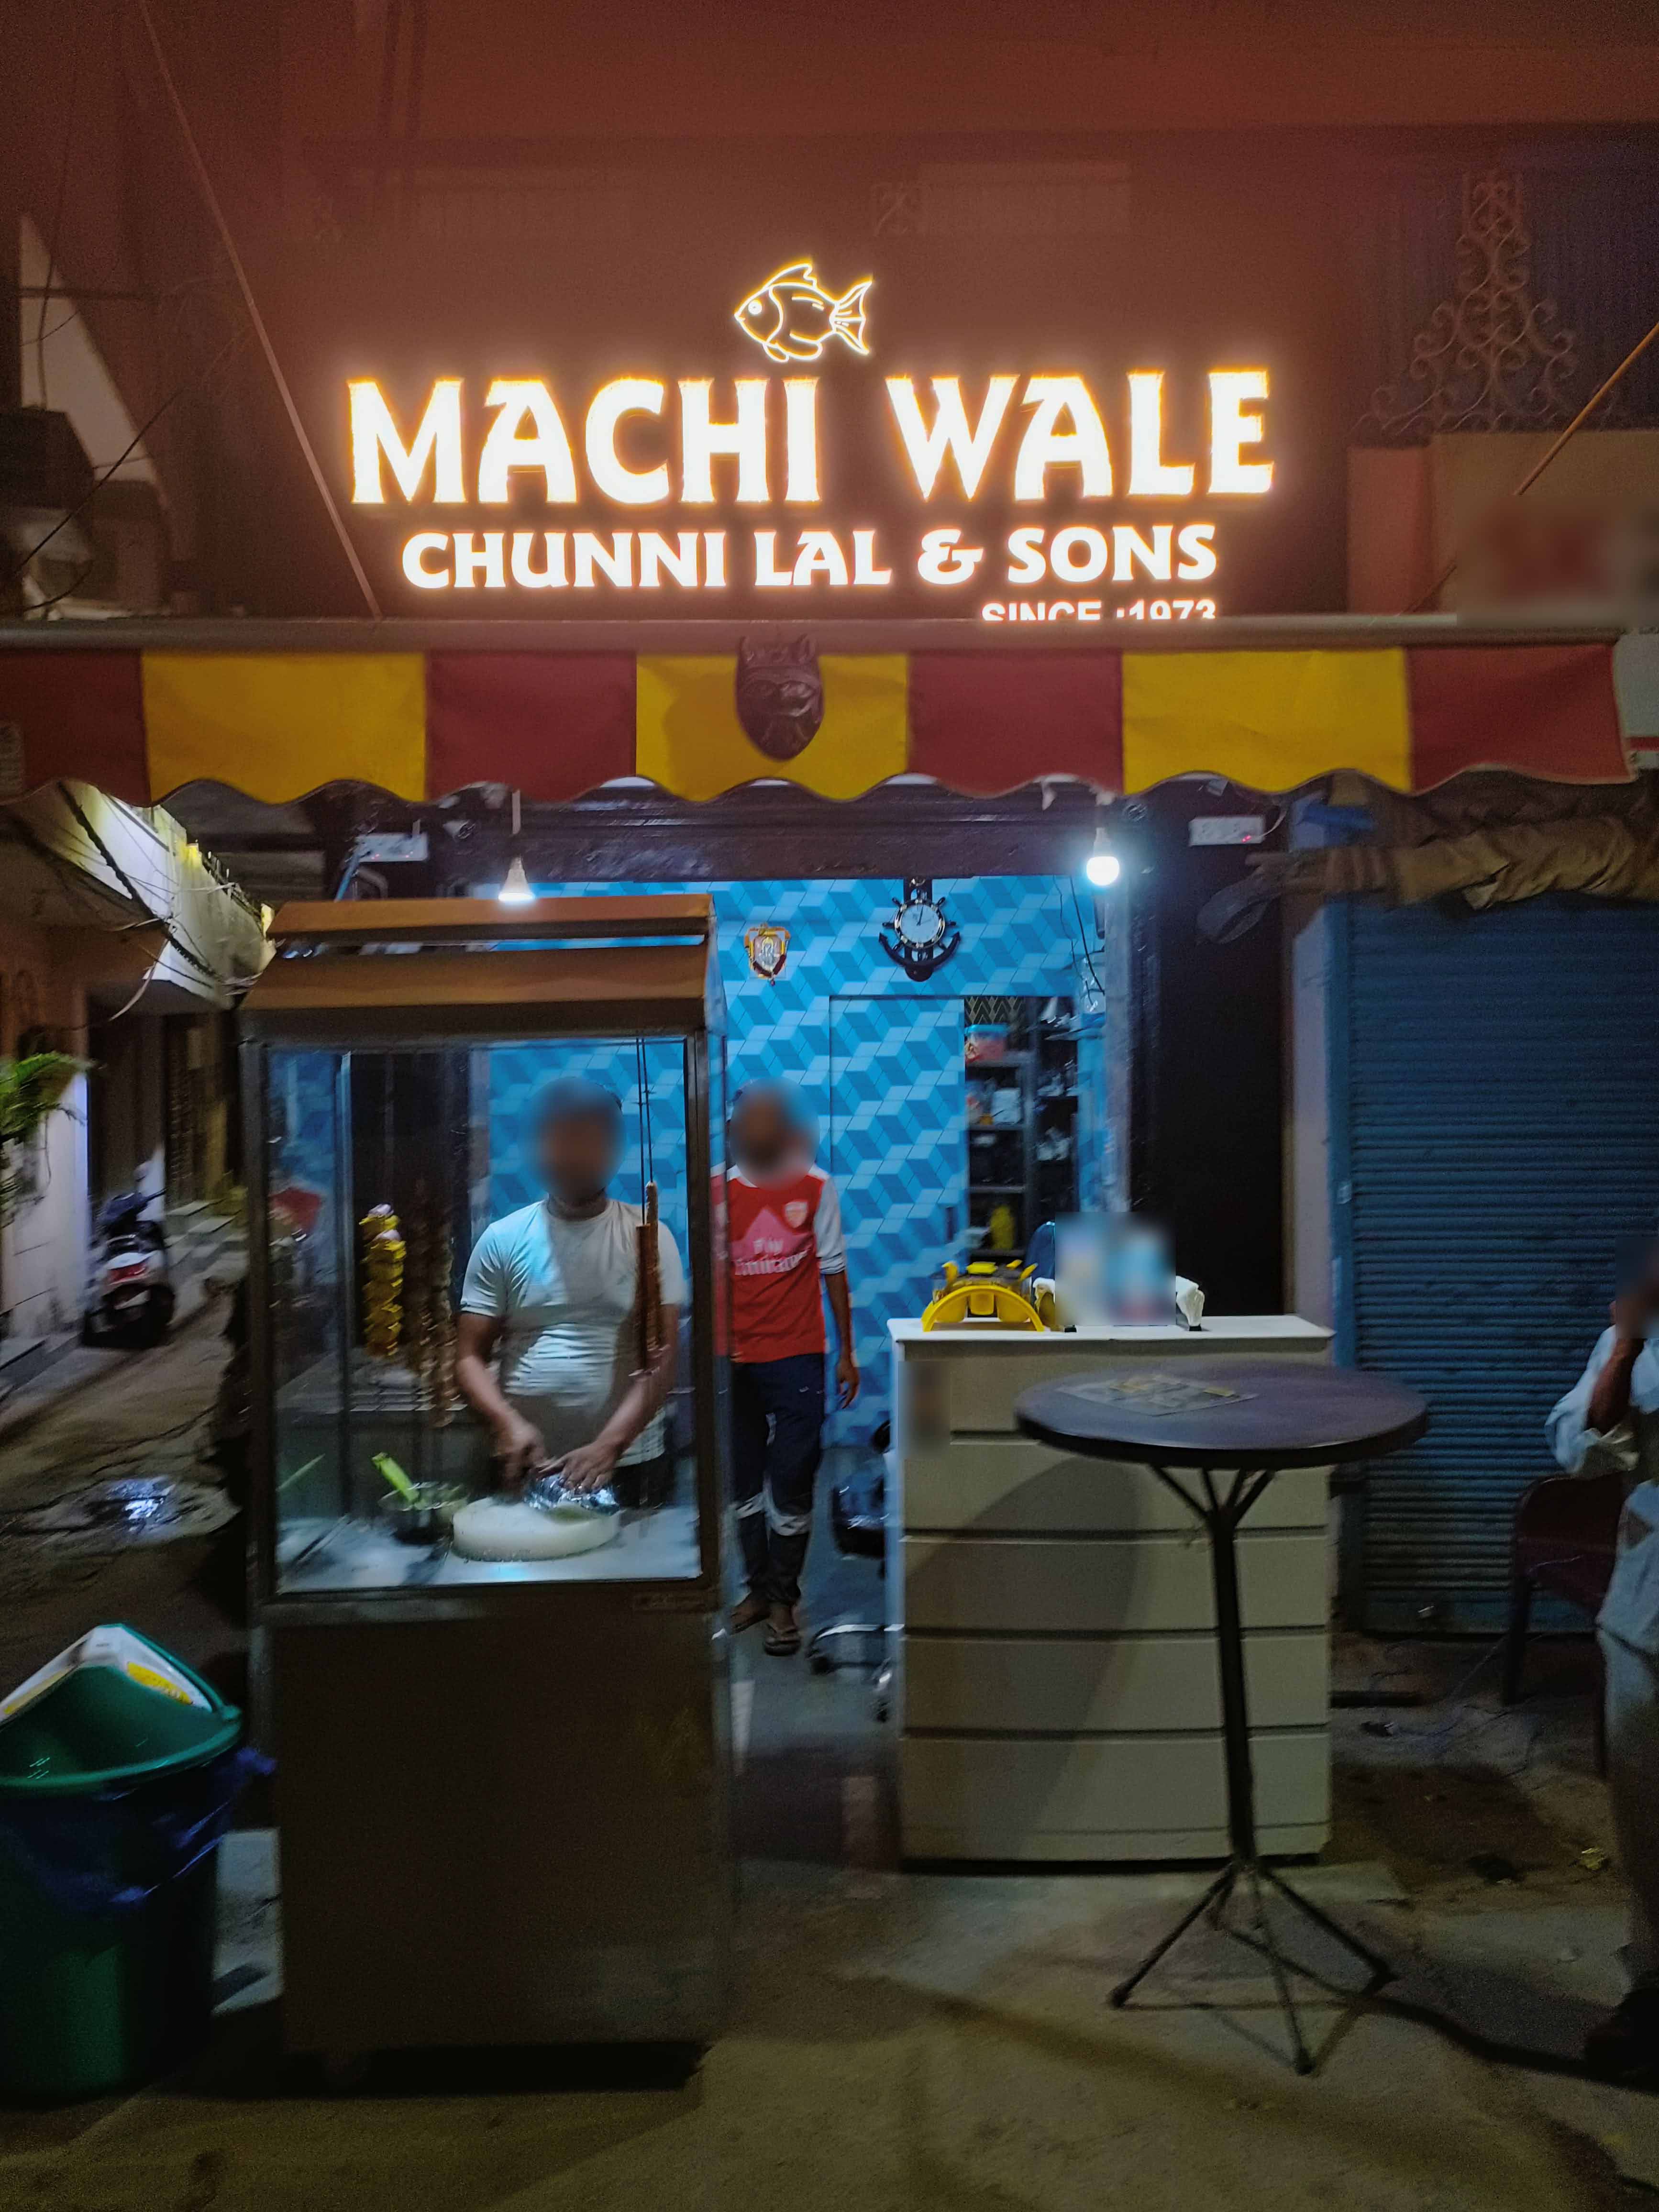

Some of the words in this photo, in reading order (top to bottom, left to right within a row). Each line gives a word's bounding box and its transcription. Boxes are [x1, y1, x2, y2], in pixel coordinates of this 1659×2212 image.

[348, 377, 820, 504] MACHI
[886, 371, 1273, 500] WALE
[403, 532, 726, 588] CHUNNI
[754, 531, 891, 586] LAL
[918, 529, 983, 584] &
[1008, 524, 1216, 583] SONS
